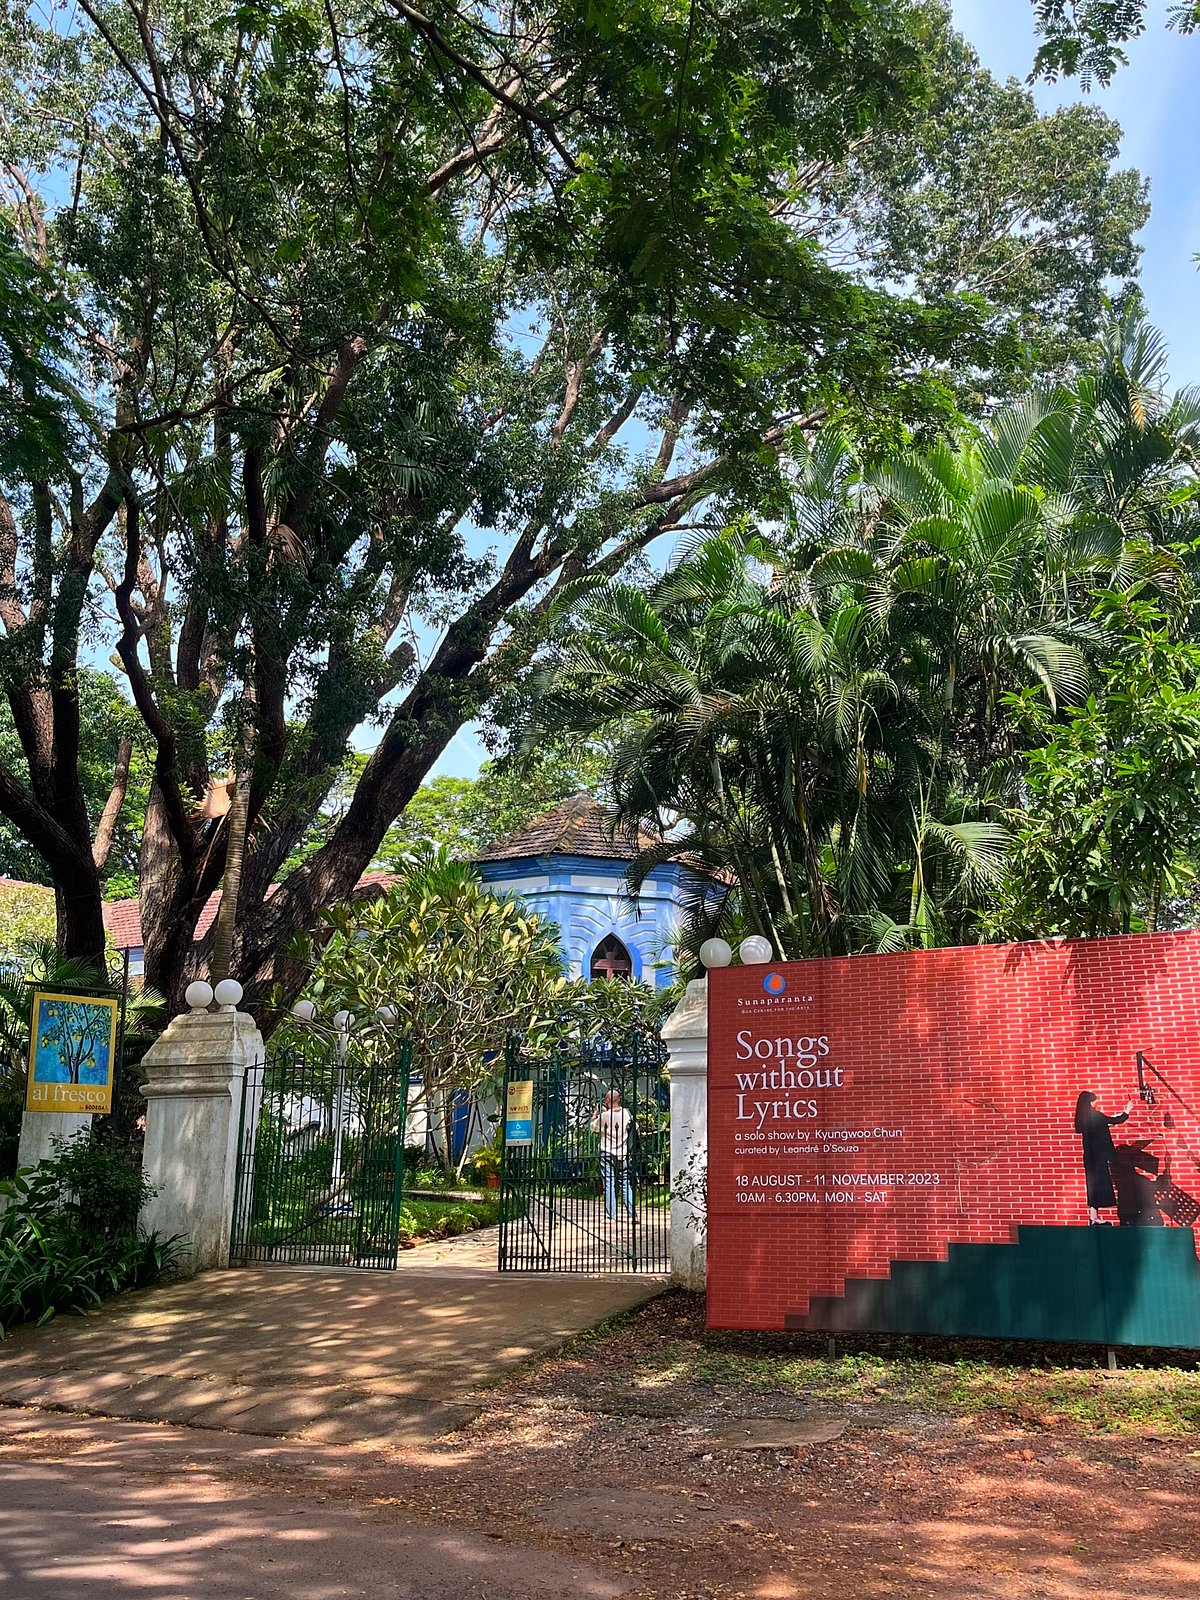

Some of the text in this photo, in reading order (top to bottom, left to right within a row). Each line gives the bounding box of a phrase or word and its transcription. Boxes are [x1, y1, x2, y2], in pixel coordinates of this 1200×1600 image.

[737, 995, 813, 1006] Sunaparanta
[736, 1030, 830, 1069] Songs
[735, 1059, 844, 1091] without
[32, 1084, 106, 1103] al fresco
[735, 1093, 818, 1130] Lyrics
[735, 1127, 903, 1141] a solo show by Kyungwoo Chun
[734, 1144, 859, 1155] curated by Leandré D'Souza
[735, 1175, 749, 1187] 18
[751, 1174, 803, 1187] AUGUST
[814, 1174, 826, 1186] 11
[832, 1174, 905, 1186] NOVEMBER
[907, 1173, 940, 1185] 2023
[735, 1192, 766, 1203] 10AM
[825, 1191, 855, 1203] MON
[864, 1191, 888, 1203] SAT
